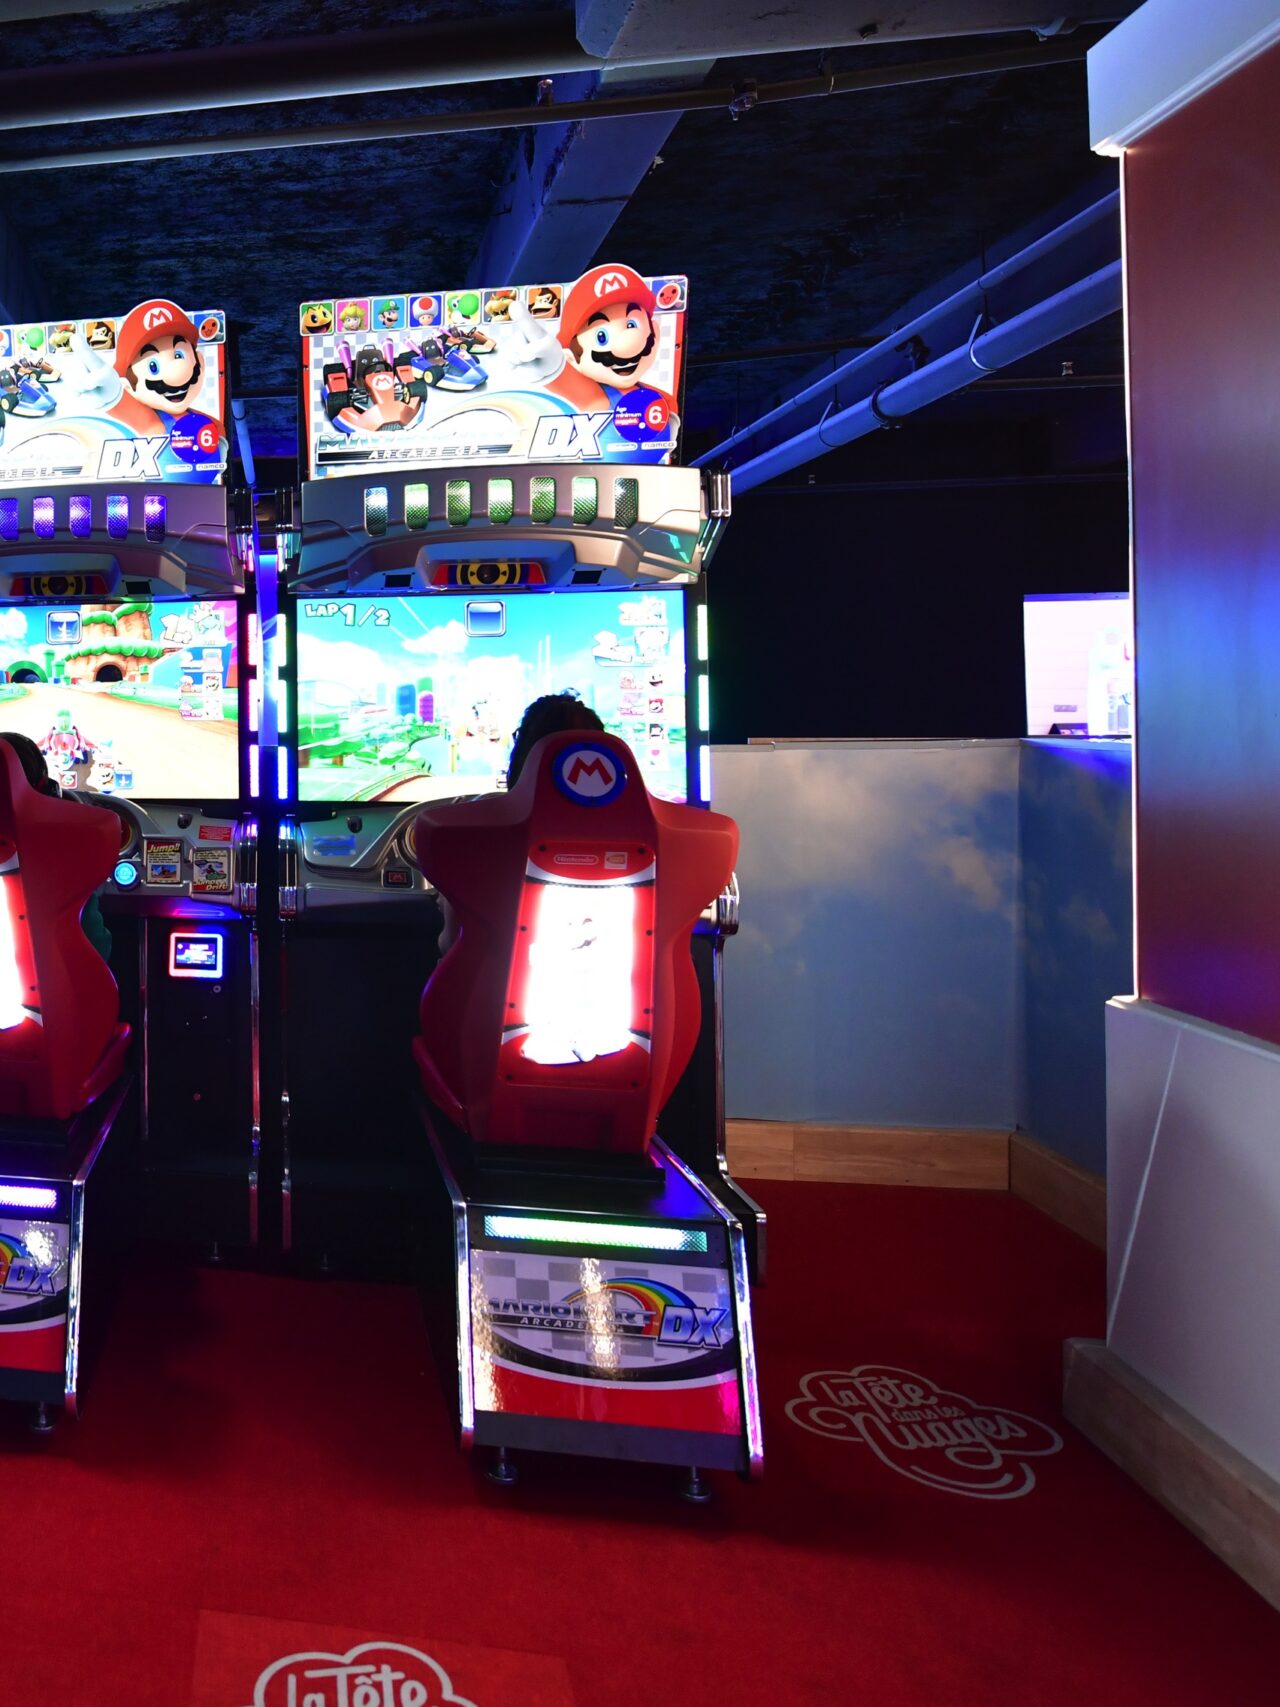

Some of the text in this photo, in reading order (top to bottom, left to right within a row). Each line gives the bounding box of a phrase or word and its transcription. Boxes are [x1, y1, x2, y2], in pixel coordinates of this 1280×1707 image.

[599, 274, 628, 298] M
[147, 309, 173, 330] M
[648, 405, 663, 425] 6
[200, 429, 213, 447] 6
[528, 411, 613, 460] DX
[97, 436, 169, 479] DX
[304, 602, 391, 627] LAP 1/2
[566, 756, 614, 786] M
[146, 842, 181, 854] Jump!!
[1, 1256, 62, 1296] DX
[519, 1315, 586, 1329] ARCADE
[656, 1303, 731, 1349] DX
[819, 1376, 938, 1423] la Tête
[891, 1405, 966, 1423] dans les
